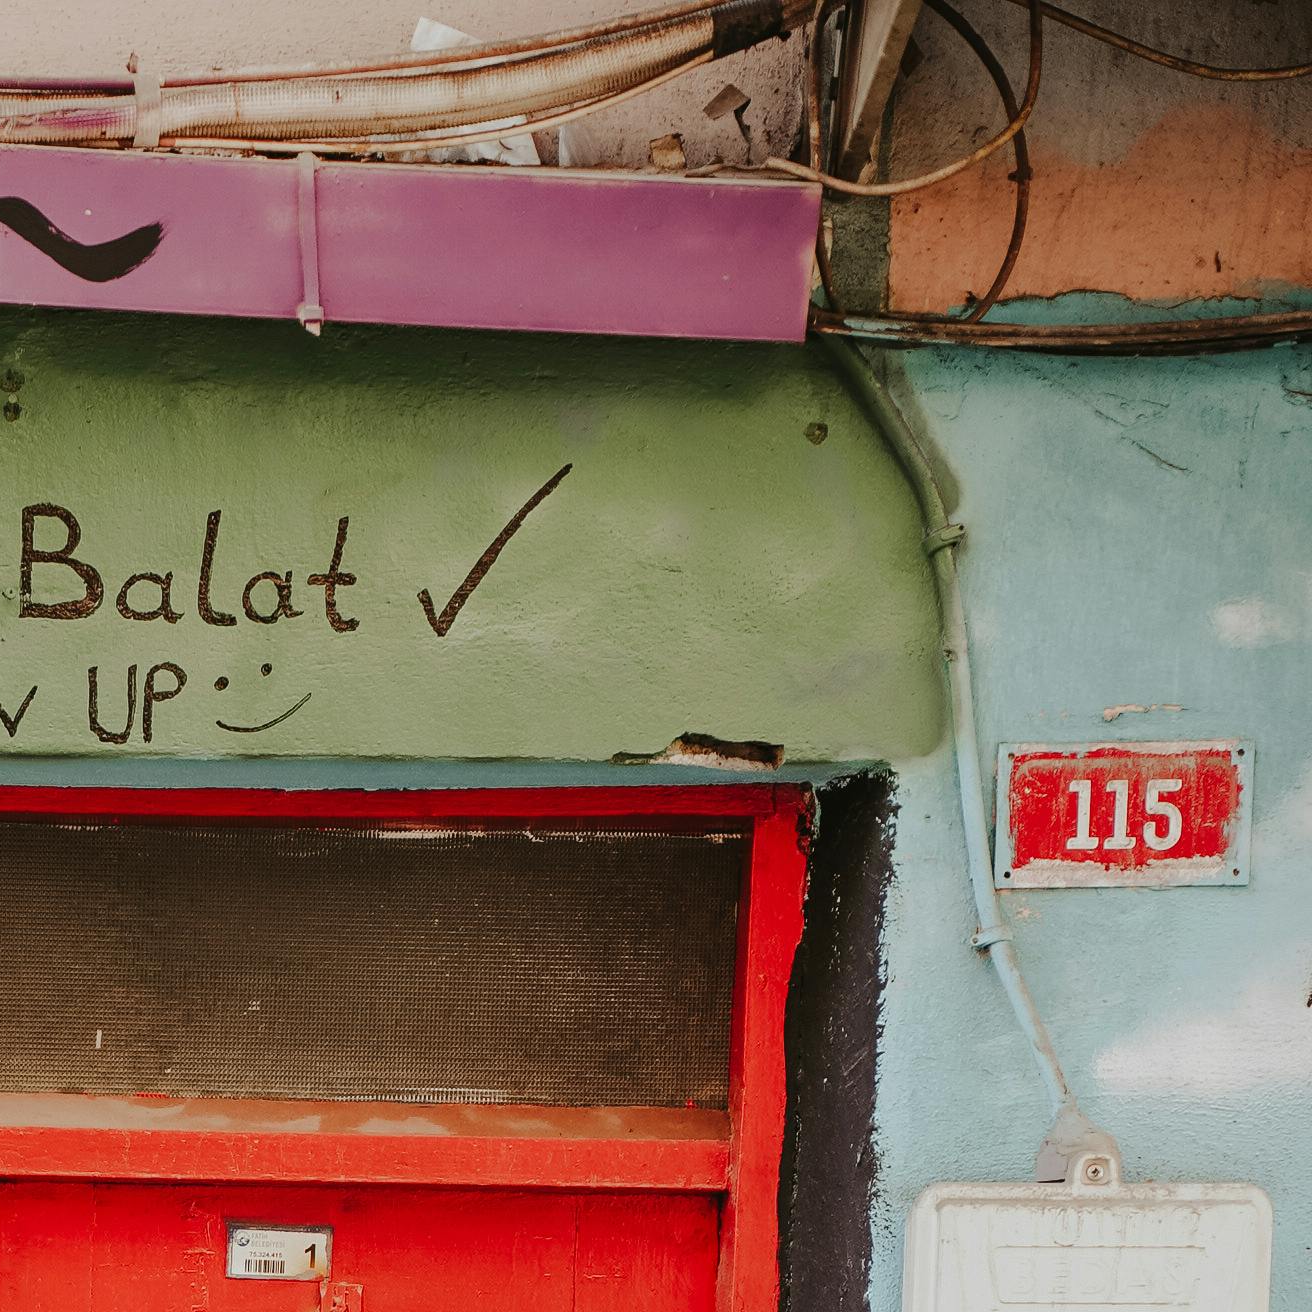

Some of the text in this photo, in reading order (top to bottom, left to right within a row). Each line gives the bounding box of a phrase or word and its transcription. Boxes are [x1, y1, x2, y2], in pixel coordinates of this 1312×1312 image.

[19, 502, 361, 633] Balat
[87, 661, 188, 745] UP
[1065, 778, 1184, 851] 115
[304, 1243, 316, 1269] 1
